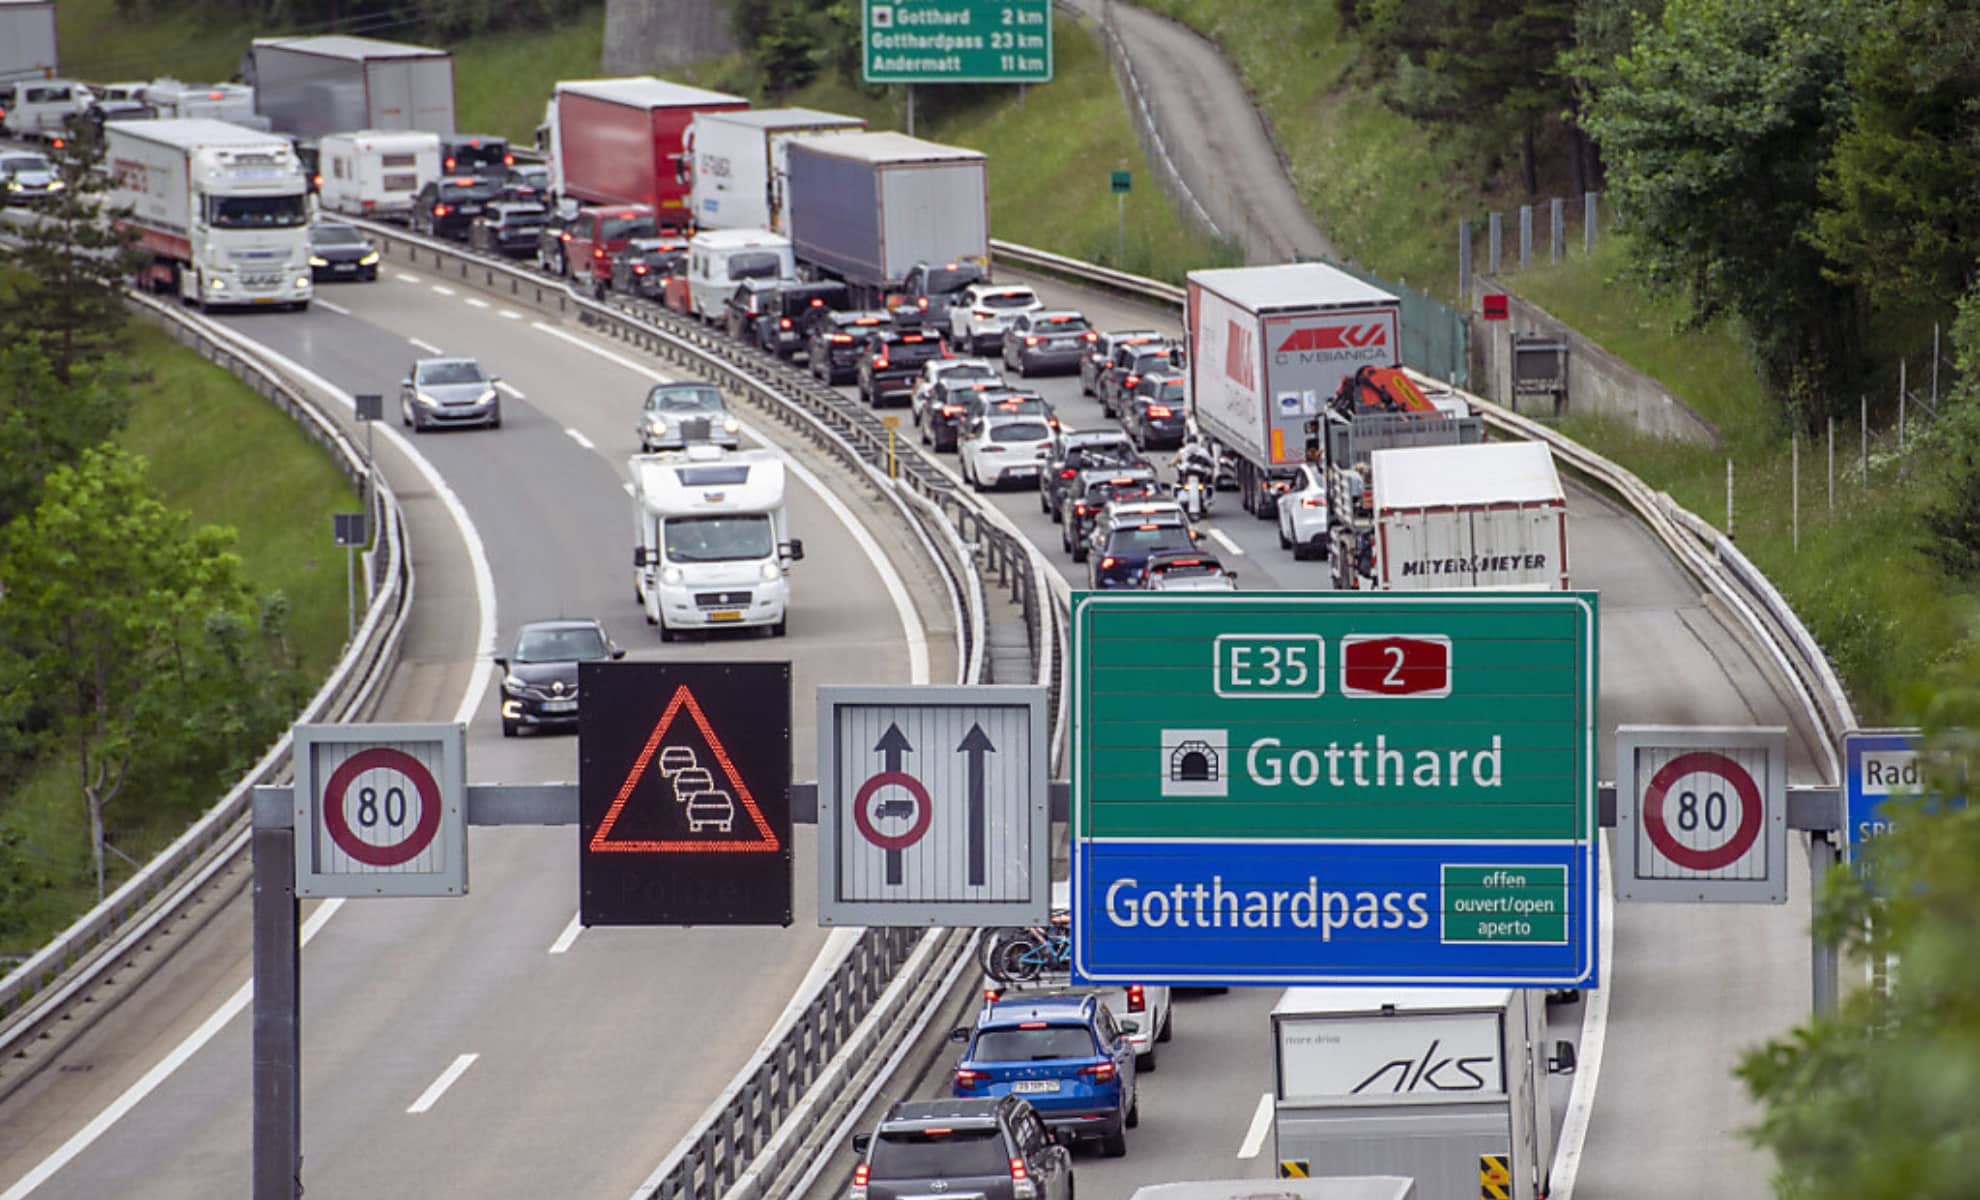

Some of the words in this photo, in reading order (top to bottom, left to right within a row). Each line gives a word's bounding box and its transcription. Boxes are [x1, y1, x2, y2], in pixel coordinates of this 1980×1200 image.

[897, 9, 970, 25] Gotthard
[1001, 9, 1013, 25] 2
[1018, 9, 1043, 25] km
[871, 32, 983, 52] Gotthardpass
[990, 32, 1014, 49] 23
[1018, 32, 1043, 48] km
[873, 55, 961, 71] Andermatt
[1001, 55, 1015, 71] 11
[1018, 55, 1043, 71] km
[1382, 646, 1406, 686] 2
[1246, 734, 1502, 787] Gotthard
[358, 786, 407, 828] 80
[1678, 790, 1727, 832] 80
[1482, 871, 1527, 888] offen
[1105, 875, 1430, 942] Gotthardpass
[1455, 896, 1555, 917] ouvert/open
[1477, 920, 1532, 939] aperto
